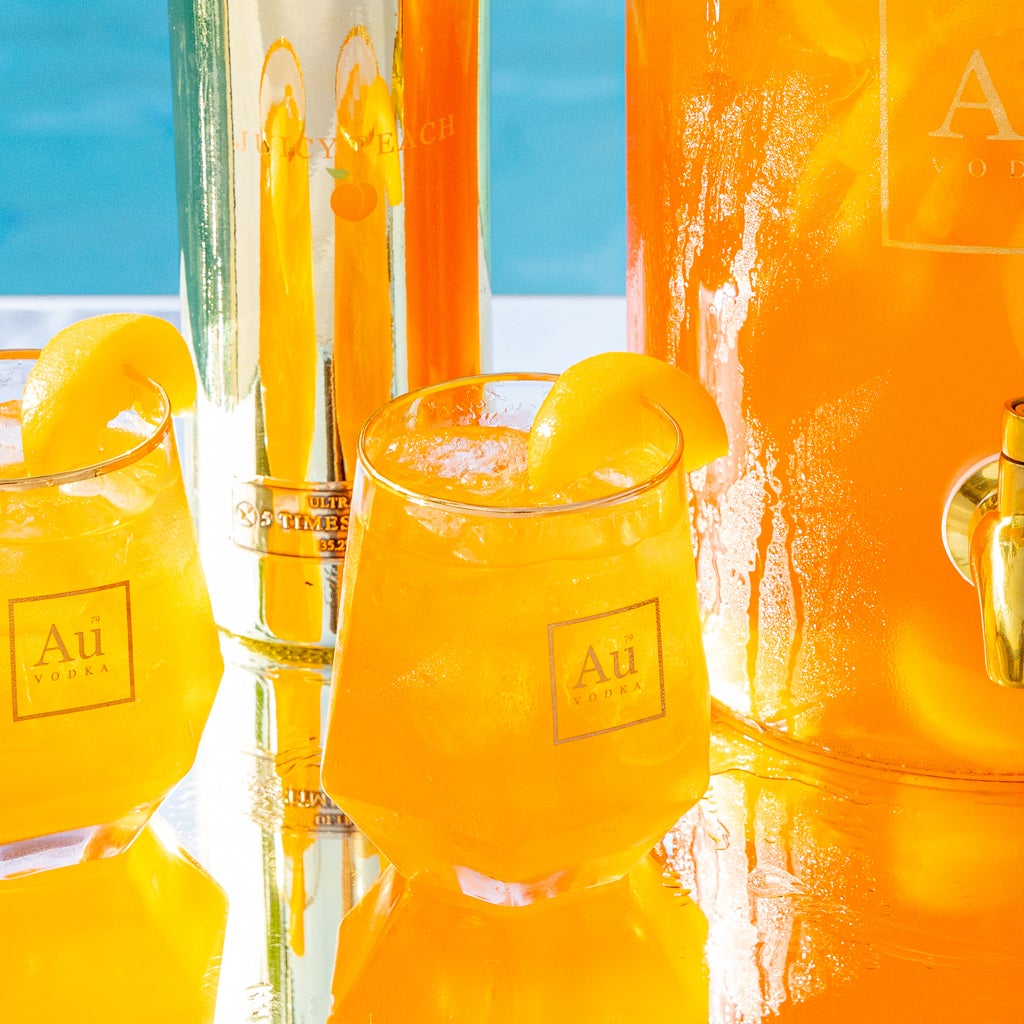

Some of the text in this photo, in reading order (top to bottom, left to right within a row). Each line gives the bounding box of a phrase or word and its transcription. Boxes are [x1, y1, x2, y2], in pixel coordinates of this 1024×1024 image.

[308, 496, 350, 509] ULTR
[278, 511, 350, 531] TIMES
[320, 539, 348, 552] 35.2
[33, 623, 105, 667] Au
[34, 664, 109, 684] VODKA
[572, 645, 638, 690] Au
[574, 682, 641, 705] VODKA
